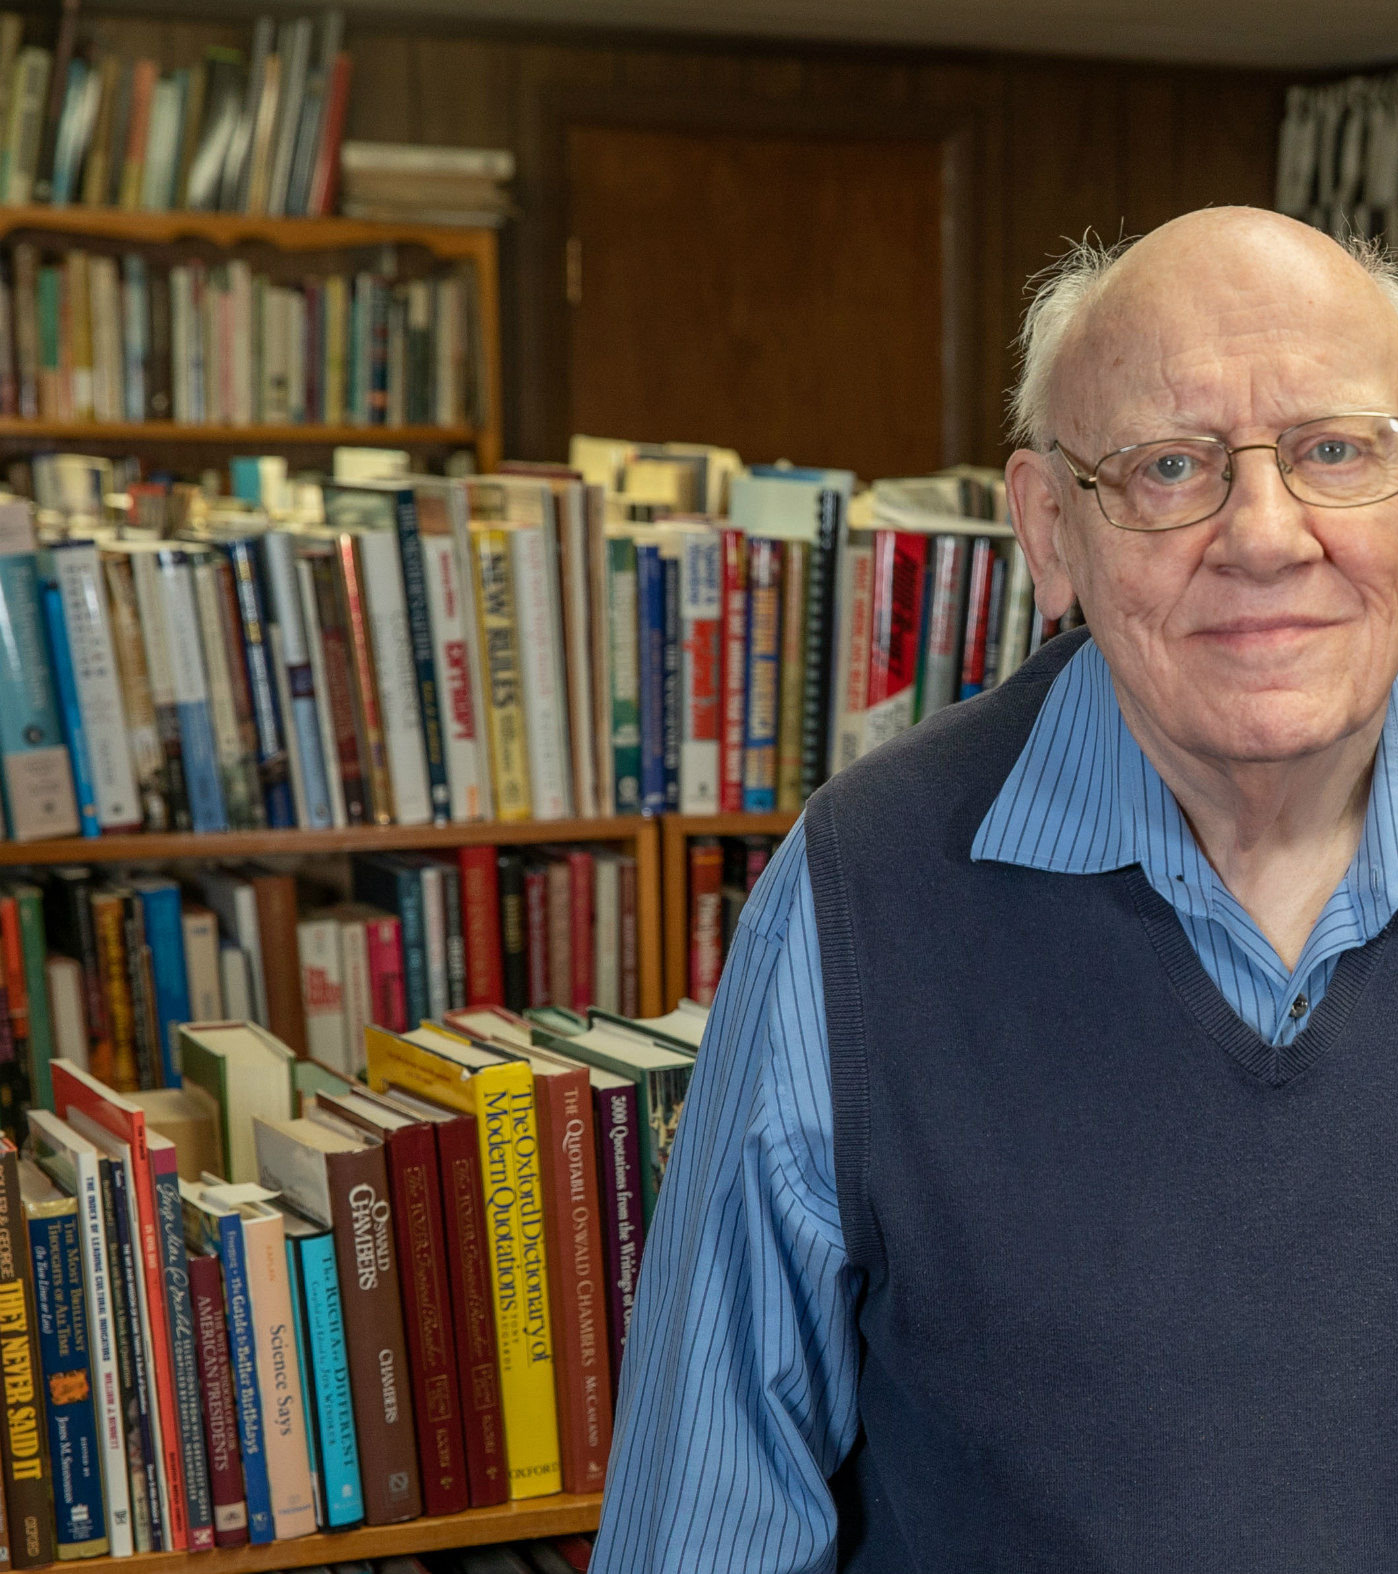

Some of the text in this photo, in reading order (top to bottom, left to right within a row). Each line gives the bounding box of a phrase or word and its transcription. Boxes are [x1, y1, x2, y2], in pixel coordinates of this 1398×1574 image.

[484, 554, 520, 710] NEW RULES
[611, 1096, 628, 1124] 5000
[86, 1176, 97, 1193] THE
[609, 1125, 631, 1190] Quotations
[87, 1195, 99, 1220] INDEX
[89, 1224, 99, 1234] OF
[484, 1091, 519, 1313] Modern Quotations
[511, 1085, 552, 1364] The Oxford Dictionary of
[562, 1087, 597, 1368] THE QUOTABLE OSWALD CHAMBERS
[616, 1191, 634, 1221] from
[618, 1221, 635, 1241] the
[1, 1227, 15, 1279] GEORGE
[47, 1221, 65, 1287] THOUGHTS
[90, 1237, 104, 1273] LEADING
[349, 1183, 378, 1290] CHAMBERS
[371, 1200, 391, 1272] OSWALD
[38, 1280, 50, 1304] Lines
[64, 1219, 88, 1352] THE MOST BRILLIANT
[617, 1242, 637, 1294] Writings
[56, 1304, 69, 1328] ALL
[233, 1295, 246, 1334] Guide
[623, 1294, 635, 1306] of
[58, 1328, 73, 1358] TIME
[237, 1346, 254, 1387] Better
[0, 1278, 42, 1481] THEY NEVER SAID IT
[197, 1296, 229, 1471] AMERICAN PRESIDENTS
[269, 1324, 295, 1436] Science Says
[325, 1286, 341, 1334] RICH
[334, 1366, 355, 1468] DIFFERENT
[378, 1349, 398, 1424] CHAMBERS
[241, 1387, 260, 1455] Birthdays
